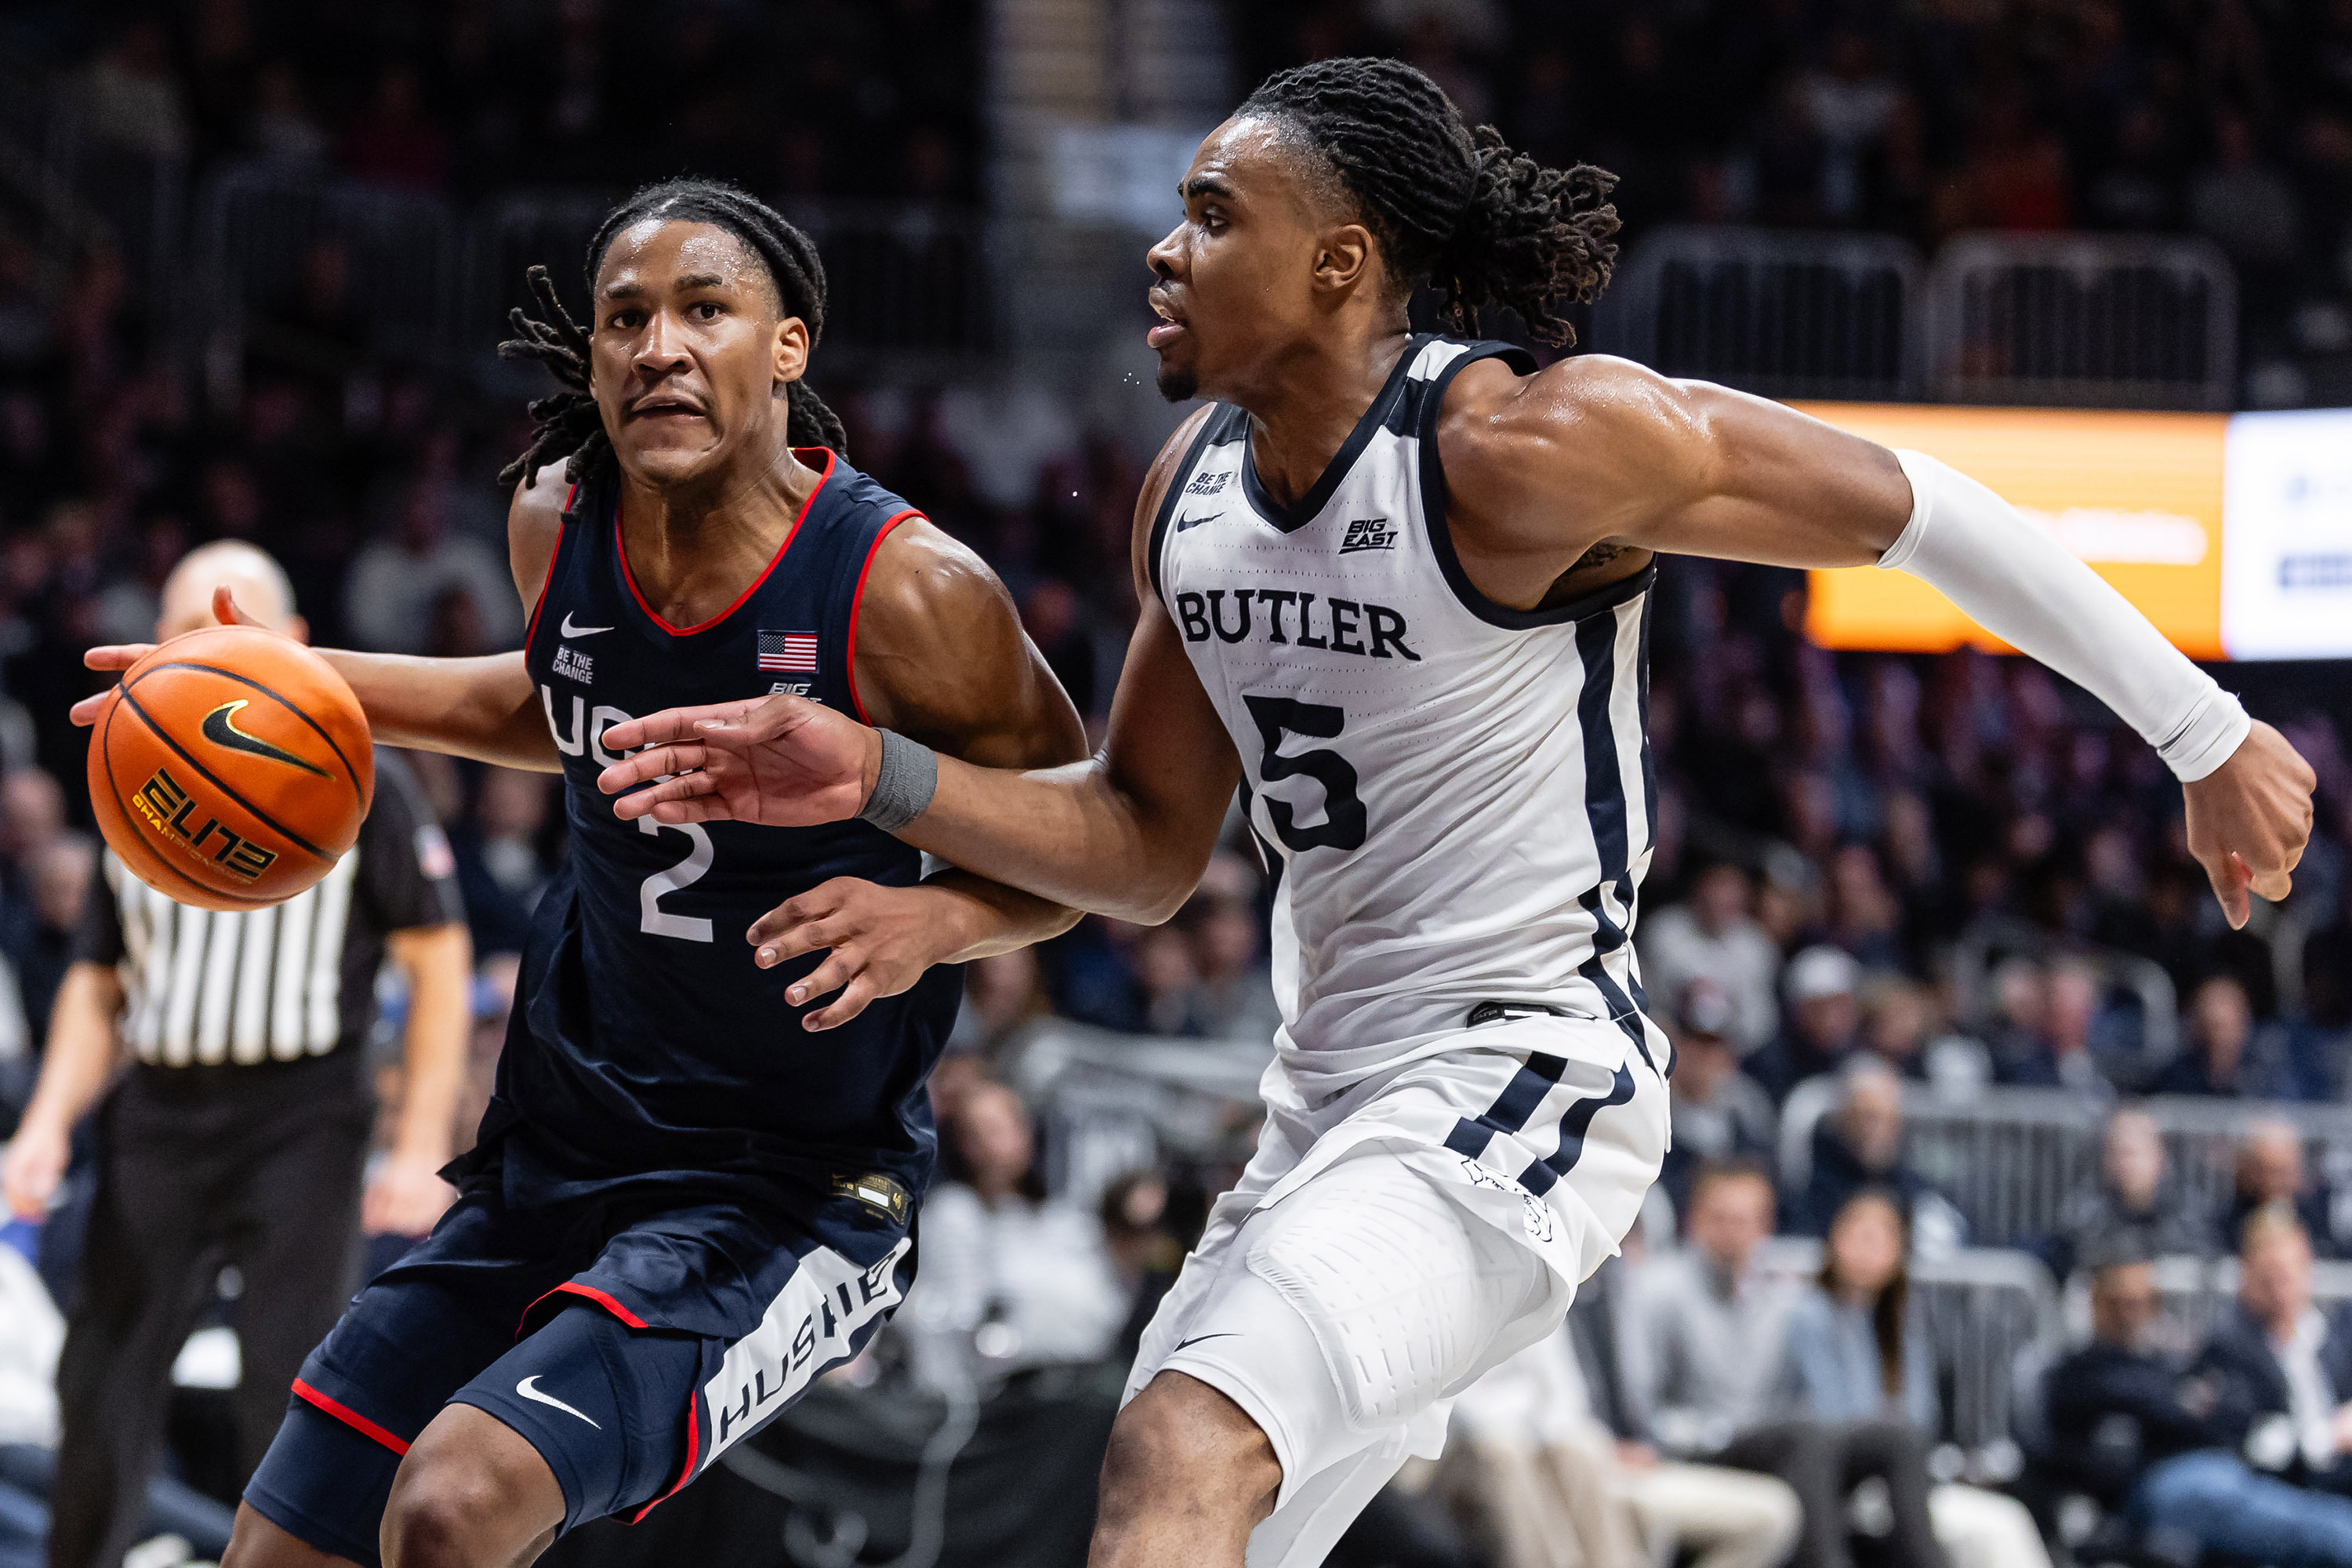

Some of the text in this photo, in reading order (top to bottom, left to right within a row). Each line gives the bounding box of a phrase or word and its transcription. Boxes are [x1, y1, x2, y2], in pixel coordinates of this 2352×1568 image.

[1196, 472, 1216, 485] BE
[1347, 517, 1388, 534] BIG
[1341, 531, 1399, 548] EAST
[1176, 588, 1422, 662] BUTLER
[557, 646, 594, 671] BE THE
[552, 659, 594, 684] CHANGE
[768, 681, 812, 696] BIG
[1242, 695, 1368, 853] 5
[139, 766, 279, 879] ELITE
[638, 813, 714, 942] 2
